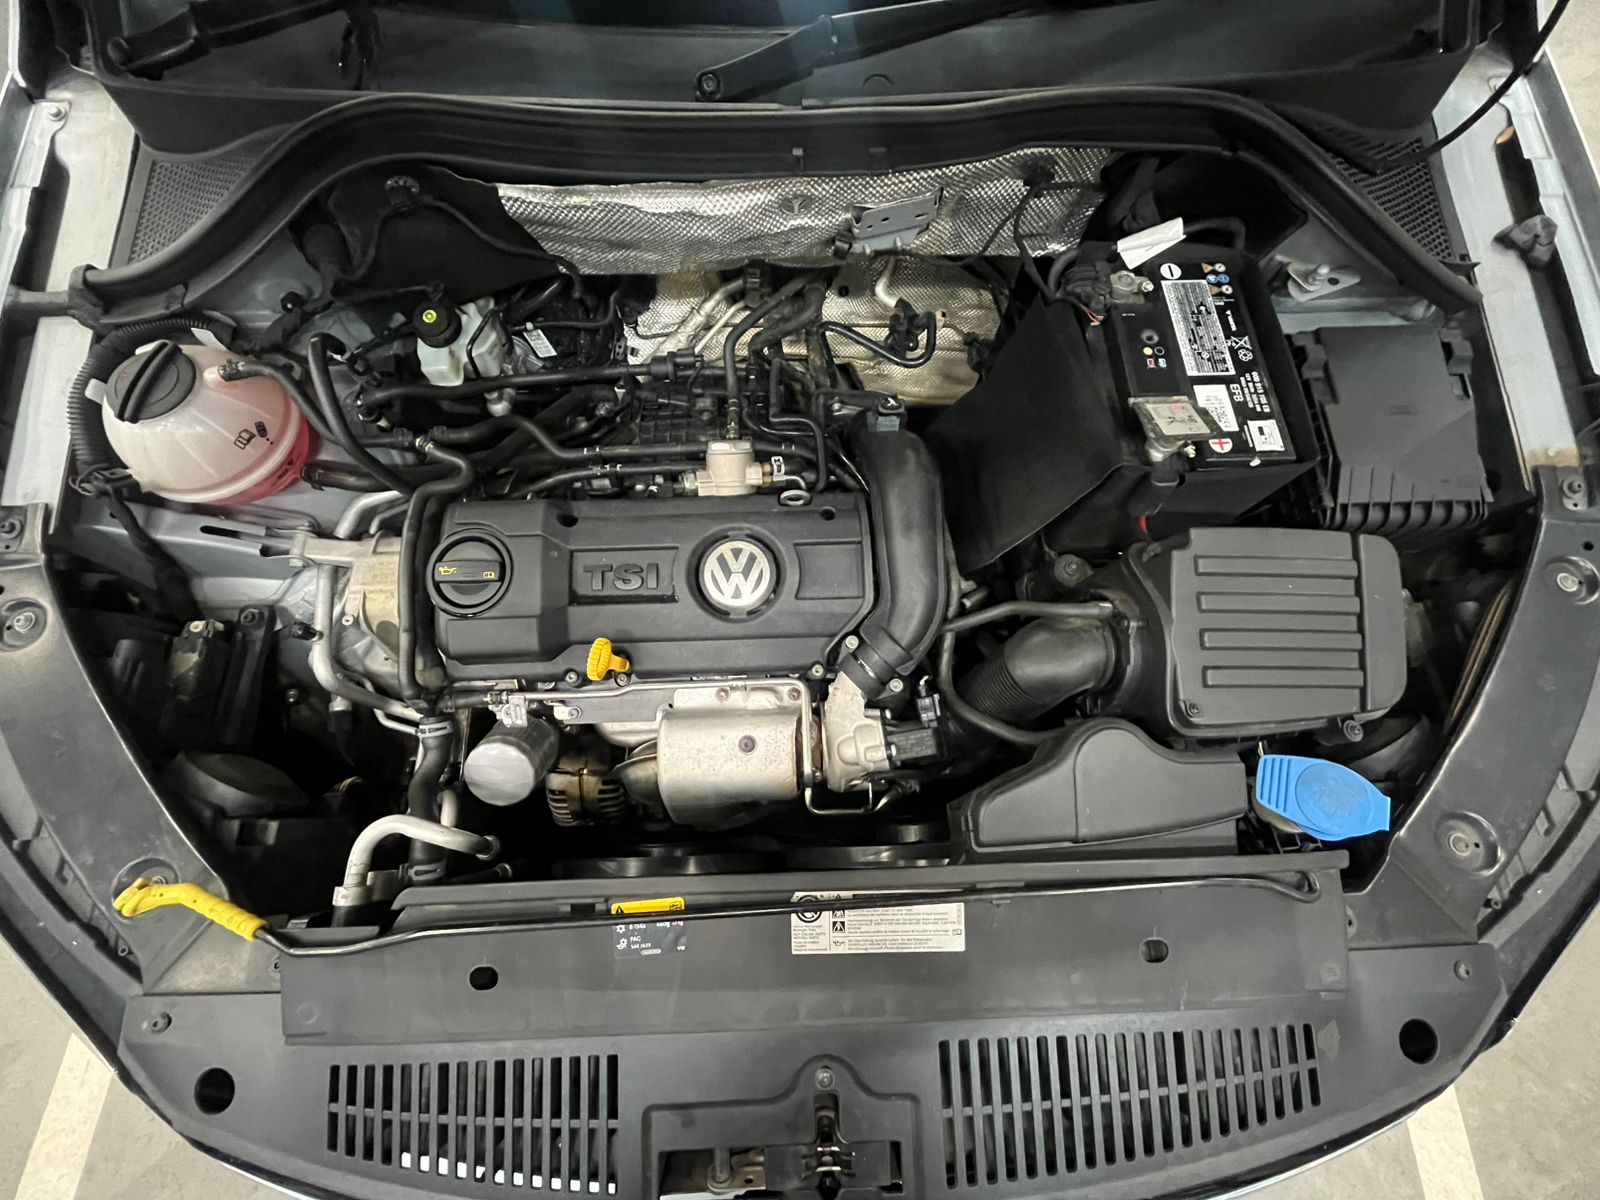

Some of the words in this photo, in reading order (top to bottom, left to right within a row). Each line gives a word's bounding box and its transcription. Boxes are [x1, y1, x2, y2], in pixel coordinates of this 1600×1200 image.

[1229, 383, 1244, 402] EFB
[583, 562, 660, 591] TSI
[703, 540, 771, 607] VW
